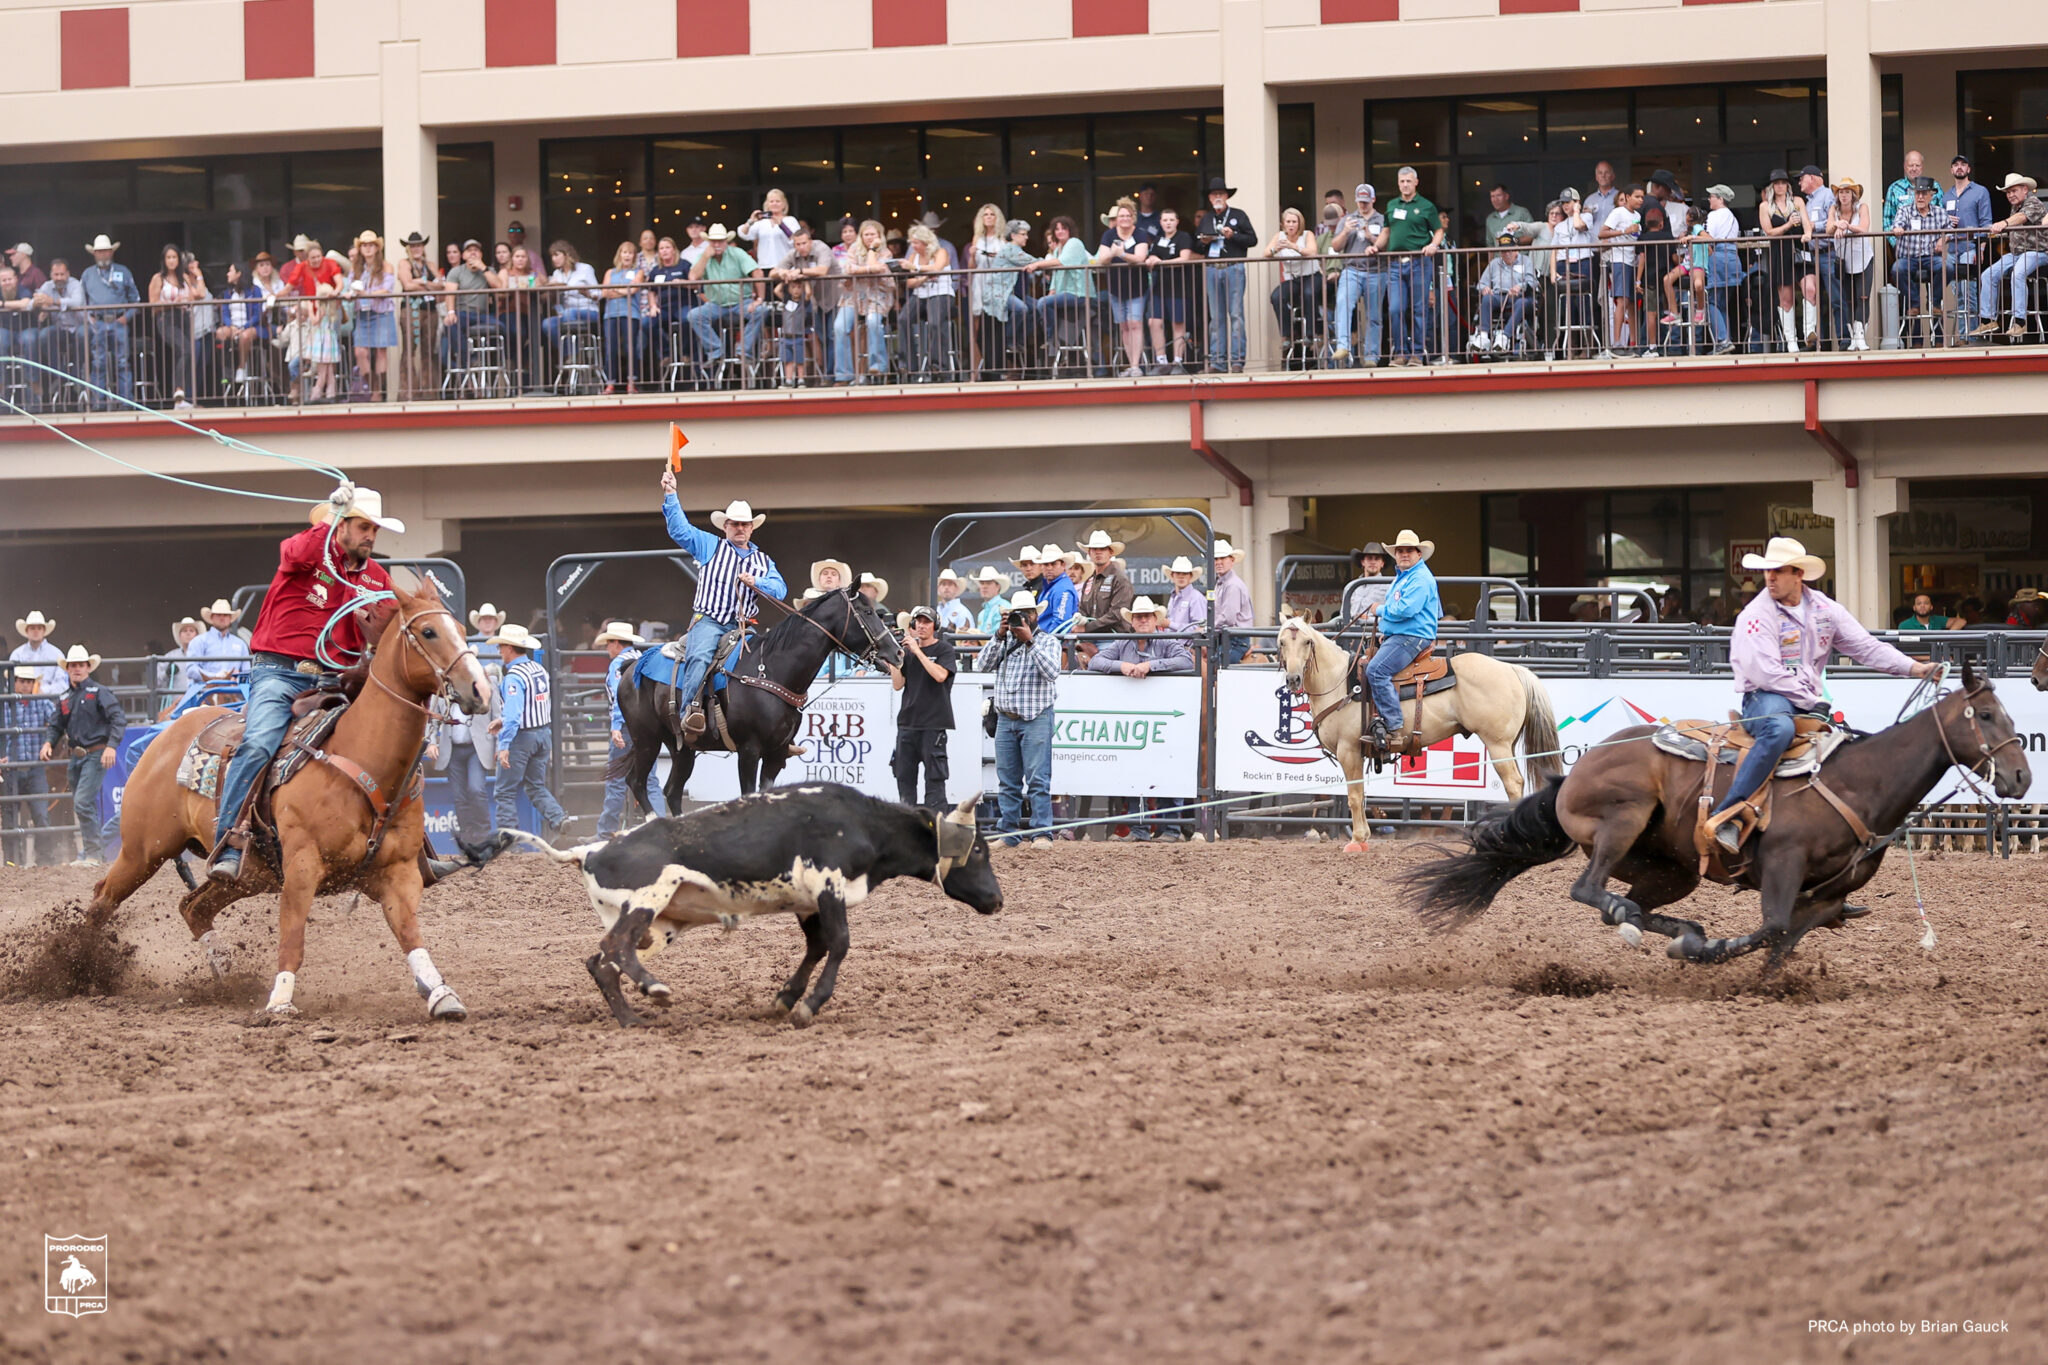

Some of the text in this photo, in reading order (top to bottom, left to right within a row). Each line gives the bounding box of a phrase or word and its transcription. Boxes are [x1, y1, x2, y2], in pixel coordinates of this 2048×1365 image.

[808, 701, 866, 712] COLORADO'S
[806, 713, 865, 738] RIB
[798, 738, 873, 765] CHOP
[806, 765, 865, 784] HOUSE
[1243, 771, 1344, 784] Rockin' B Feed & Supply
